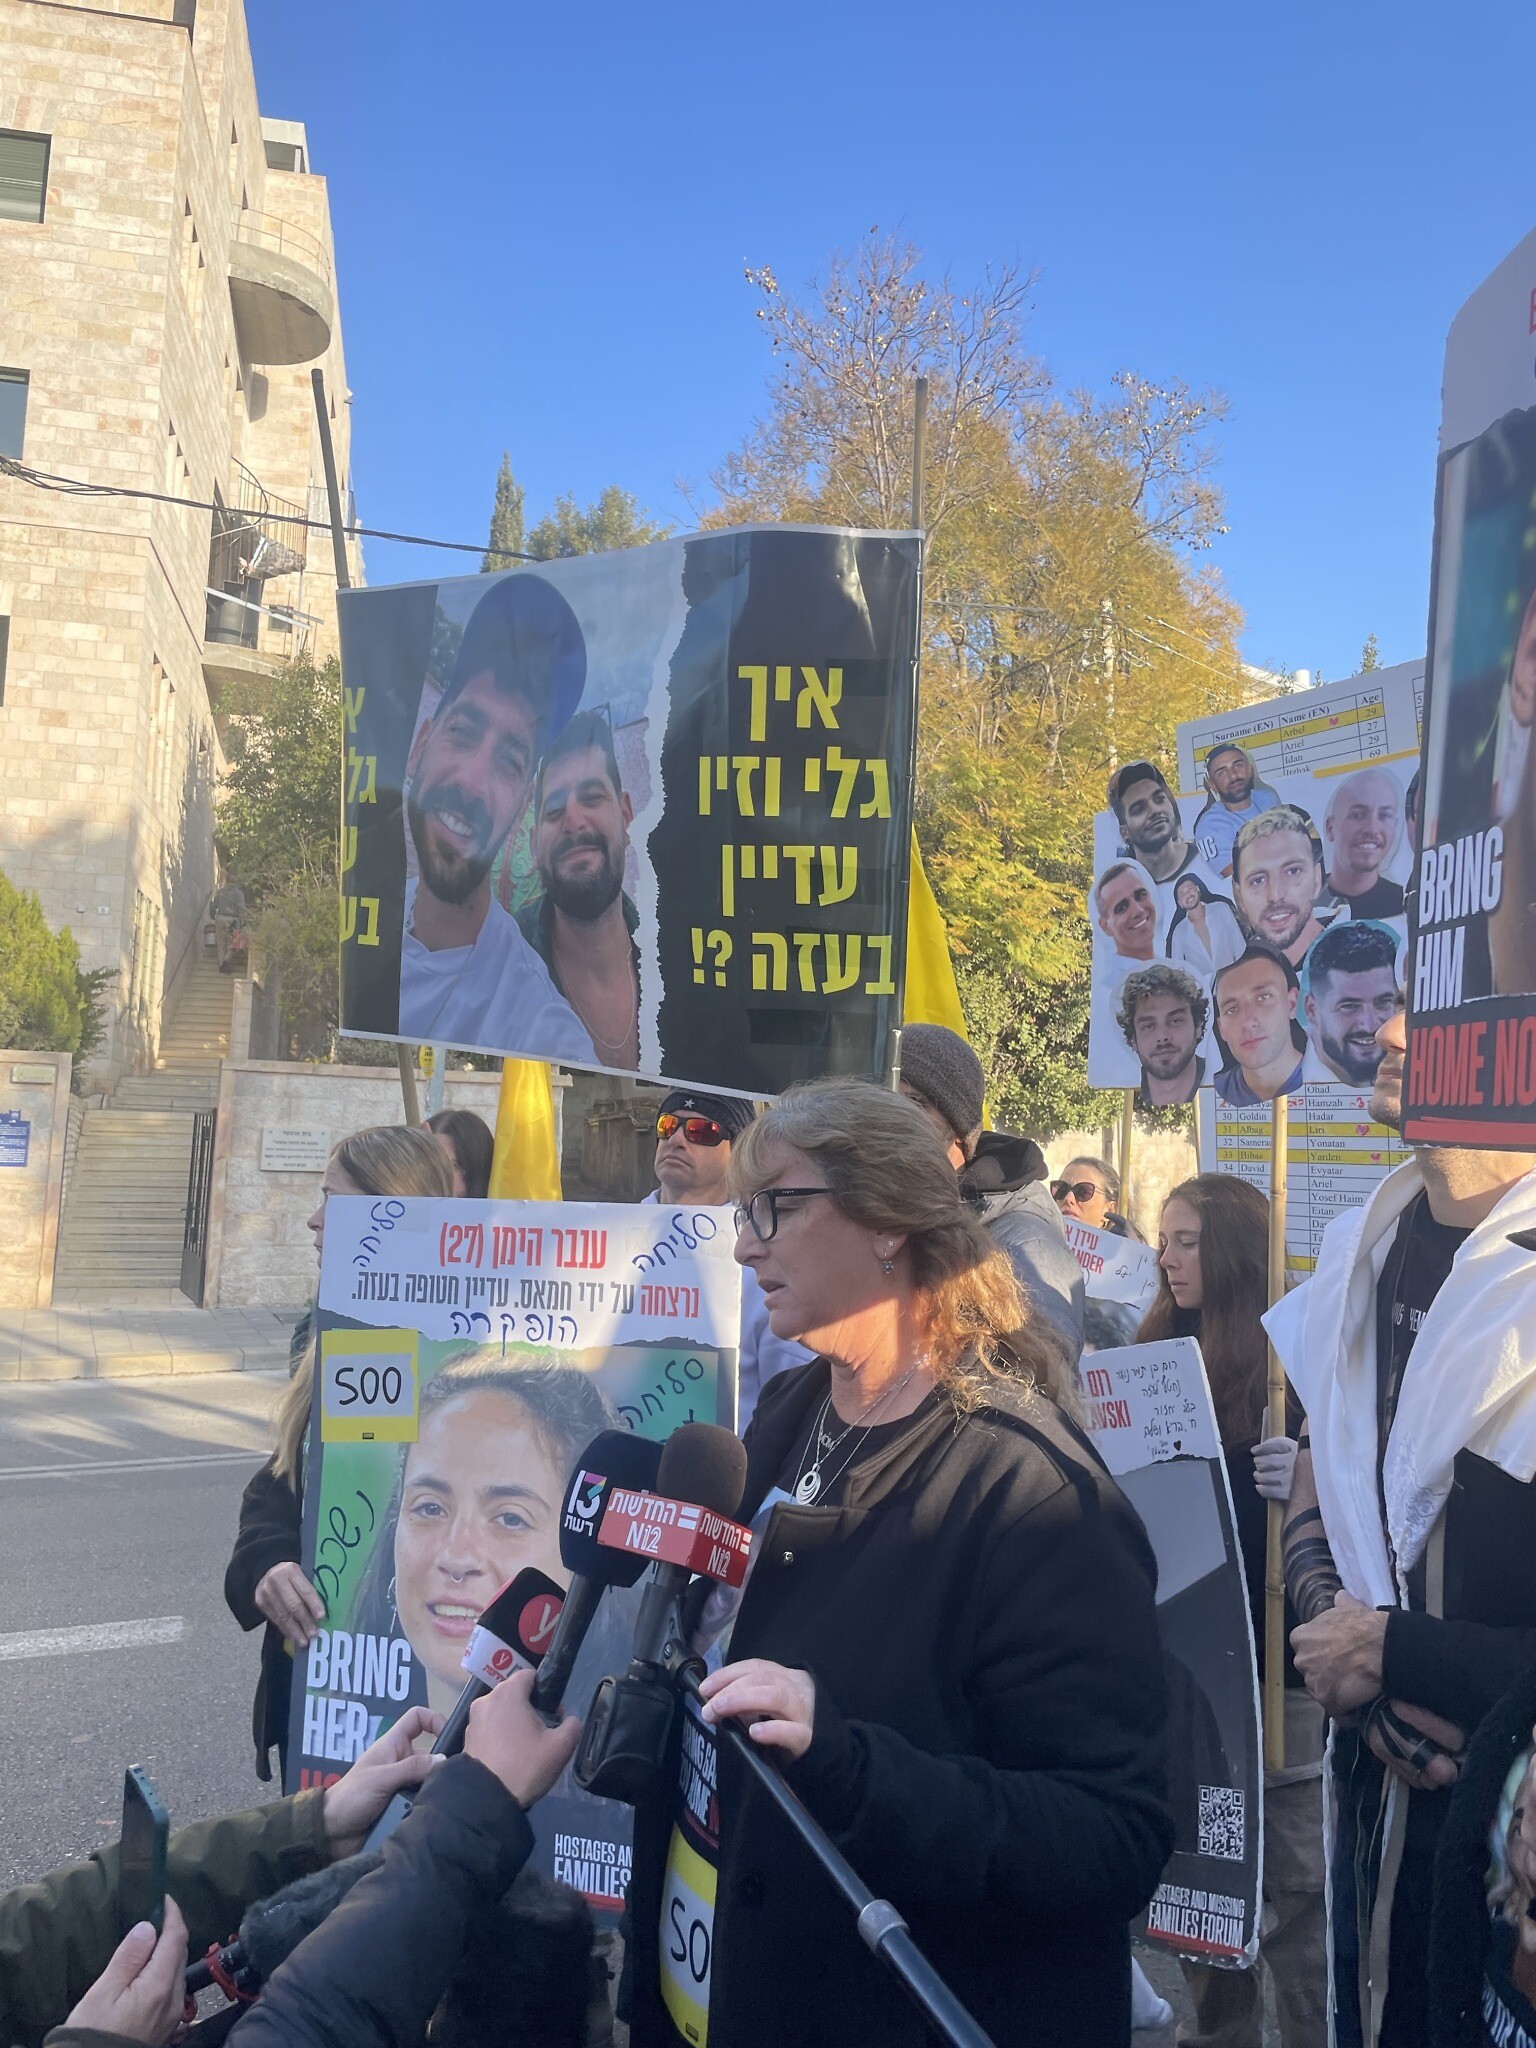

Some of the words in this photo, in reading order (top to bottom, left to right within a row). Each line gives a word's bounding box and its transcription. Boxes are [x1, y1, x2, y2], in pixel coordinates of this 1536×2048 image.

[738, 665, 842, 742] איך
[1214, 726, 1252, 743] Surname
[1254, 720, 1275, 735] (EN)
[1281, 712, 1306, 726] Name
[1308, 705, 1330, 722] (EN)
[1361, 692, 1380, 706] Age
[1283, 726, 1306, 739] Arbel
[1365, 708, 1377, 717] 29
[1284, 739, 1305, 751] Ariel
[1367, 722, 1378, 732] 27
[1285, 754, 1303, 764] Idan
[1368, 735, 1380, 745] 29
[1369, 749, 1381, 758] 69
[699, 756, 780, 817] וזיו
[804, 746, 892, 818] גלי
[722, 845, 858, 917] עדיין
[1418, 825, 1504, 928] BRING
[751, 932, 896, 996] בעזה
[1413, 926, 1466, 1014] HIM
[1408, 1021, 1488, 1107] HOME
[1307, 1085, 1330, 1094] Ohad
[1308, 1099, 1343, 1108] Hamzah
[1222, 1112, 1233, 1121] 30
[1239, 1112, 1267, 1121] Goldin
[1308, 1112, 1334, 1121] Hadar
[1222, 1125, 1233, 1134] 31
[1239, 1125, 1264, 1136] Albag
[1222, 1138, 1233, 1146] 32
[1240, 1139, 1273, 1147] Samera
[1309, 1139, 1346, 1148] Yonatan
[1223, 1151, 1233, 1159] 33
[1240, 1151, 1263, 1160] Bibas
[1310, 1152, 1341, 1161] Yarden
[1223, 1164, 1233, 1172] 34
[1241, 1164, 1265, 1173] David
[1311, 1166, 1343, 1175] Evyatar
[1311, 1179, 1332, 1188] Ariel
[1312, 1191, 1337, 1202] Yosef
[1339, 1194, 1363, 1203] Haim
[1312, 1206, 1334, 1215] Eitan
[352, 1200, 406, 1268] סליחה
[439, 1221, 484, 1269] (27)
[493, 1226, 543, 1269] הימן
[556, 1226, 608, 1269] ענבר
[632, 1213, 717, 1274] סליחה
[1074, 1229, 1099, 1251] עידן
[351, 1271, 400, 1302] בעזה.
[405, 1273, 459, 1305] חטופה
[465, 1277, 509, 1310] עדיין
[514, 1281, 573, 1311] חמאס.
[579, 1282, 606, 1313] ידי
[611, 1276, 635, 1315] על
[640, 1284, 700, 1318] נרצחה
[451, 1311, 578, 1357] הופקרה
[617, 1358, 704, 1430] סליחה
[1087, 1369, 1113, 1397] רום
[608, 1491, 678, 1525] החדשות
[564, 1514, 594, 1536] רשת
[625, 1521, 662, 1554] N12
[699, 1513, 742, 1550] החדשות
[707, 1545, 731, 1578] N12
[307, 1628, 411, 1701] BRING
[302, 1694, 368, 1763] HER
[554, 1833, 616, 1868] HOSTAGES
[617, 1844, 633, 1868] AN
[554, 1856, 632, 1899] FAMILIES
[1190, 1890, 1207, 1910] AND
[1208, 1893, 1245, 1918] MISSING
[1148, 1902, 1200, 1939] FAMILIES
[1200, 1912, 1244, 1949] FORUM
